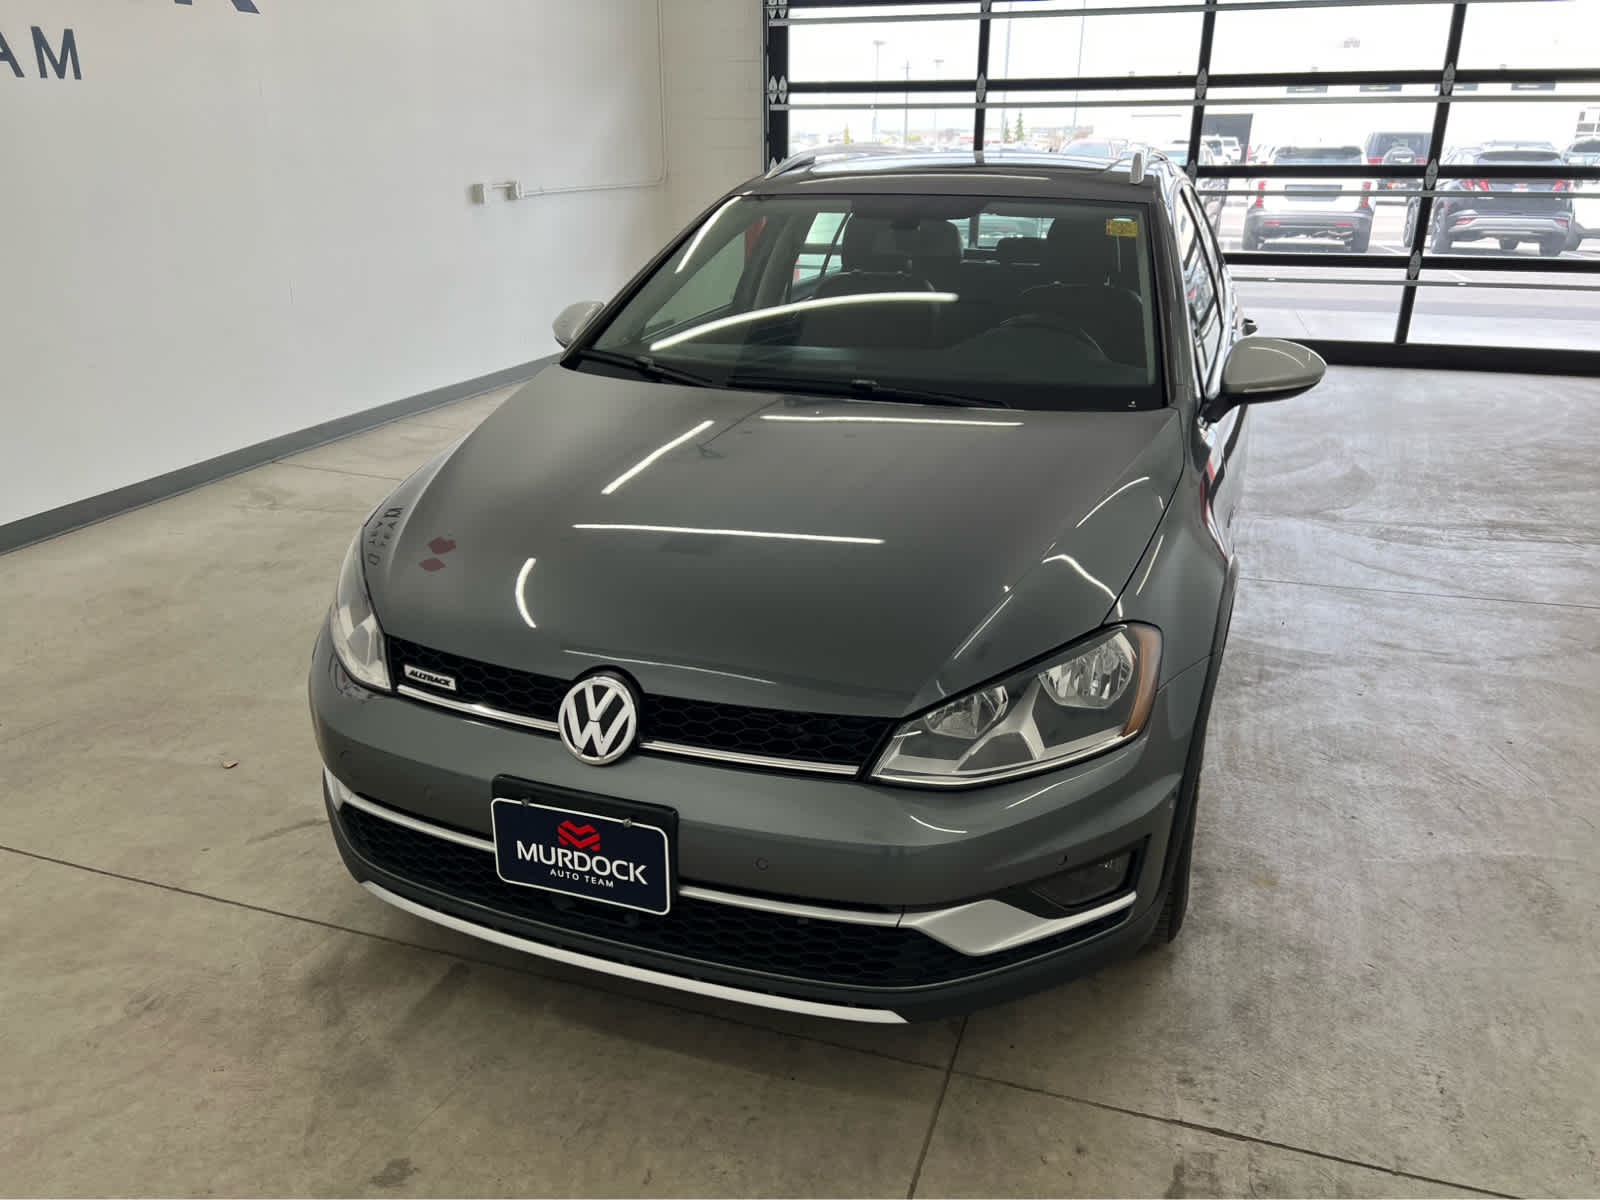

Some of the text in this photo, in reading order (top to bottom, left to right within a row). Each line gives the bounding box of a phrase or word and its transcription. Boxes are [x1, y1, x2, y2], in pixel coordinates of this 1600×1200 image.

[516, 840, 648, 885] MURDOCK
[550, 868, 614, 888] AUTO TEAM
